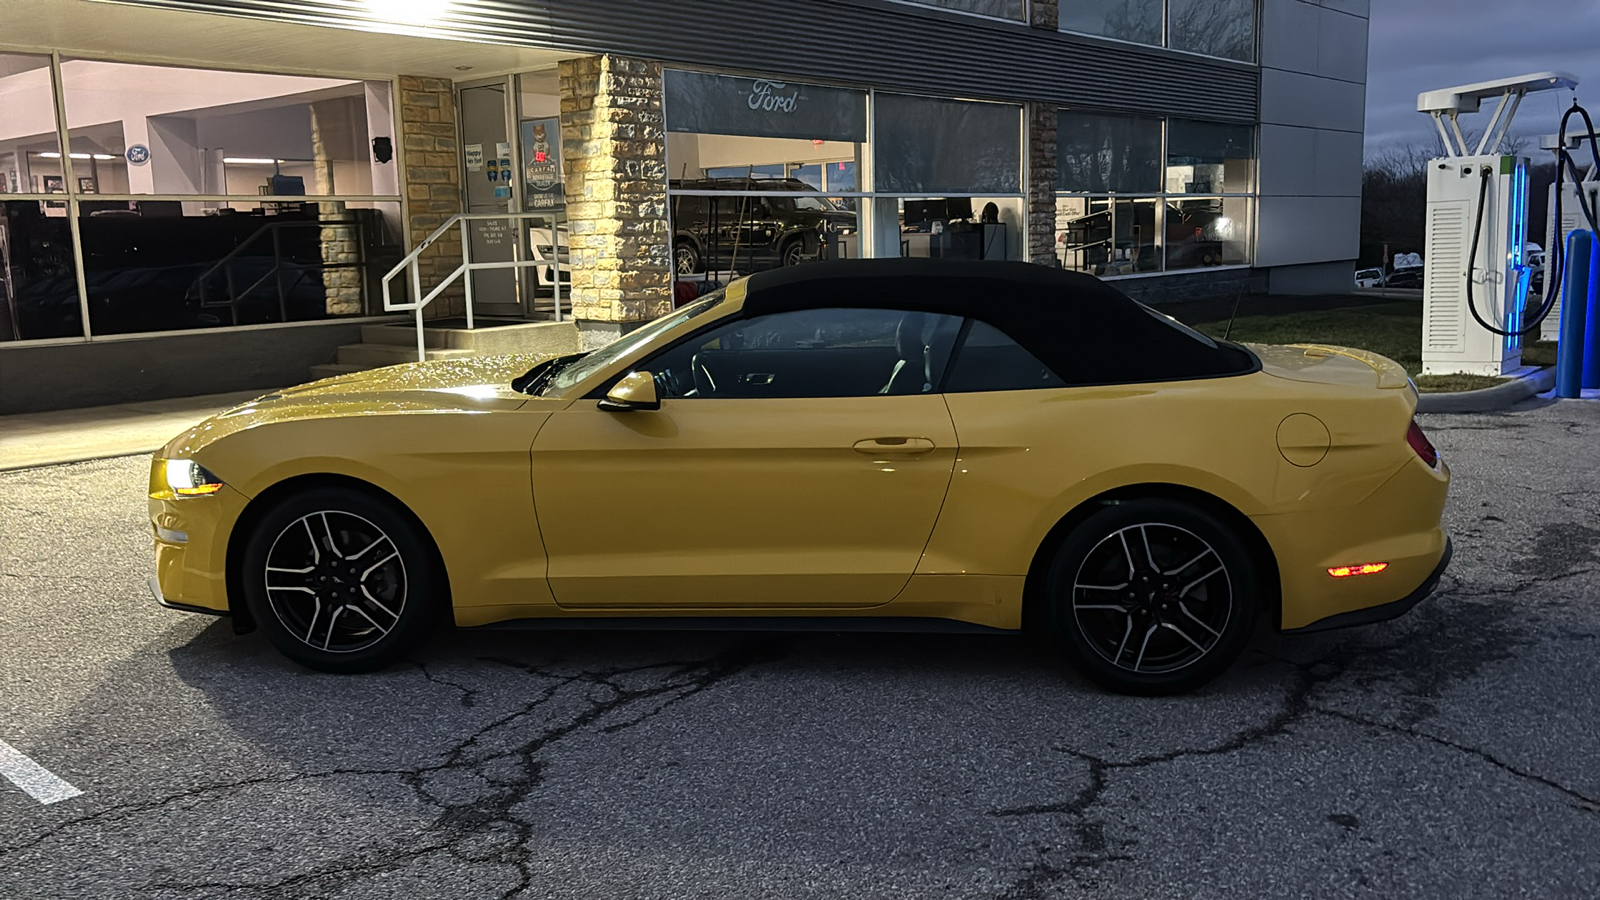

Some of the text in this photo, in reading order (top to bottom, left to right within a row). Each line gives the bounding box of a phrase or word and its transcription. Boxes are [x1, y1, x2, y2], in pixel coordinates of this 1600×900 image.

[747, 79, 798, 113] Ford
[131, 147, 146, 161] Ford
[534, 199, 554, 208] CARFAX
